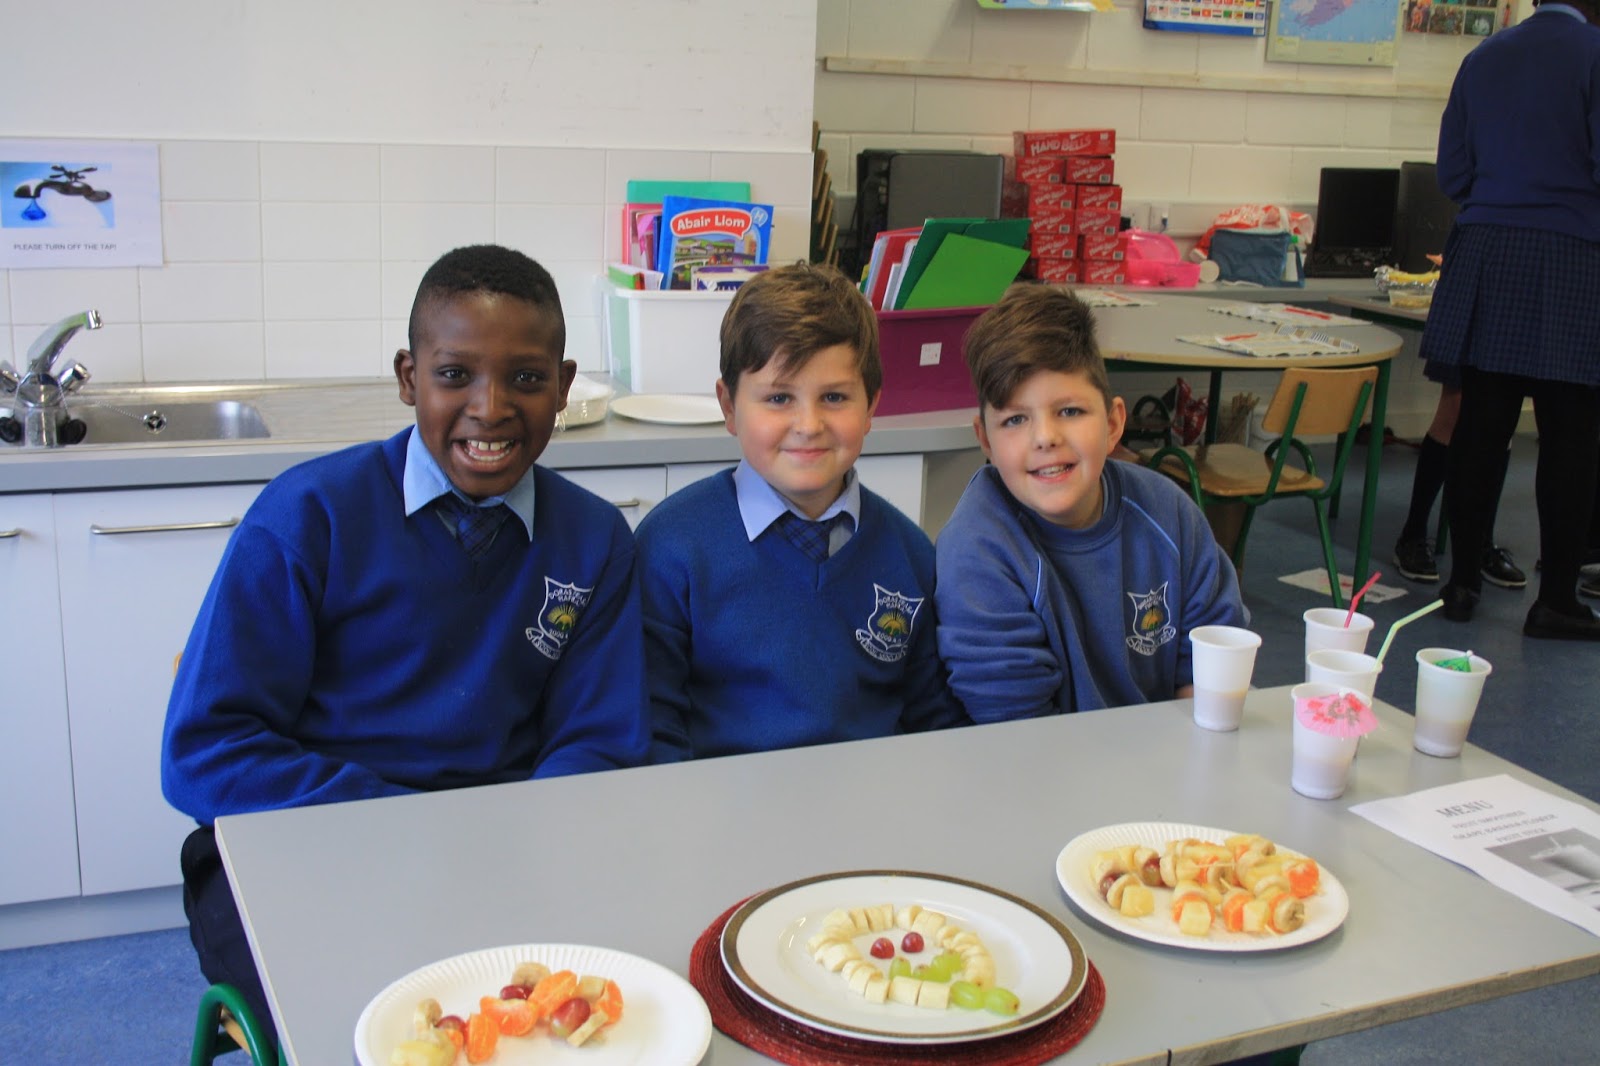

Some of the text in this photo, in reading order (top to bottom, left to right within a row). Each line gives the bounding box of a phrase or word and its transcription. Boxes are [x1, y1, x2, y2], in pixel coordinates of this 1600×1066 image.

[1030, 140, 1060, 156] HAND
[1061, 134, 1092, 152] BELLS
[677, 215, 745, 231] Abair Liom
[13, 243, 117, 251] PLEASE TURN OFF THE TAP!
[1435, 800, 1494, 818] MENU
